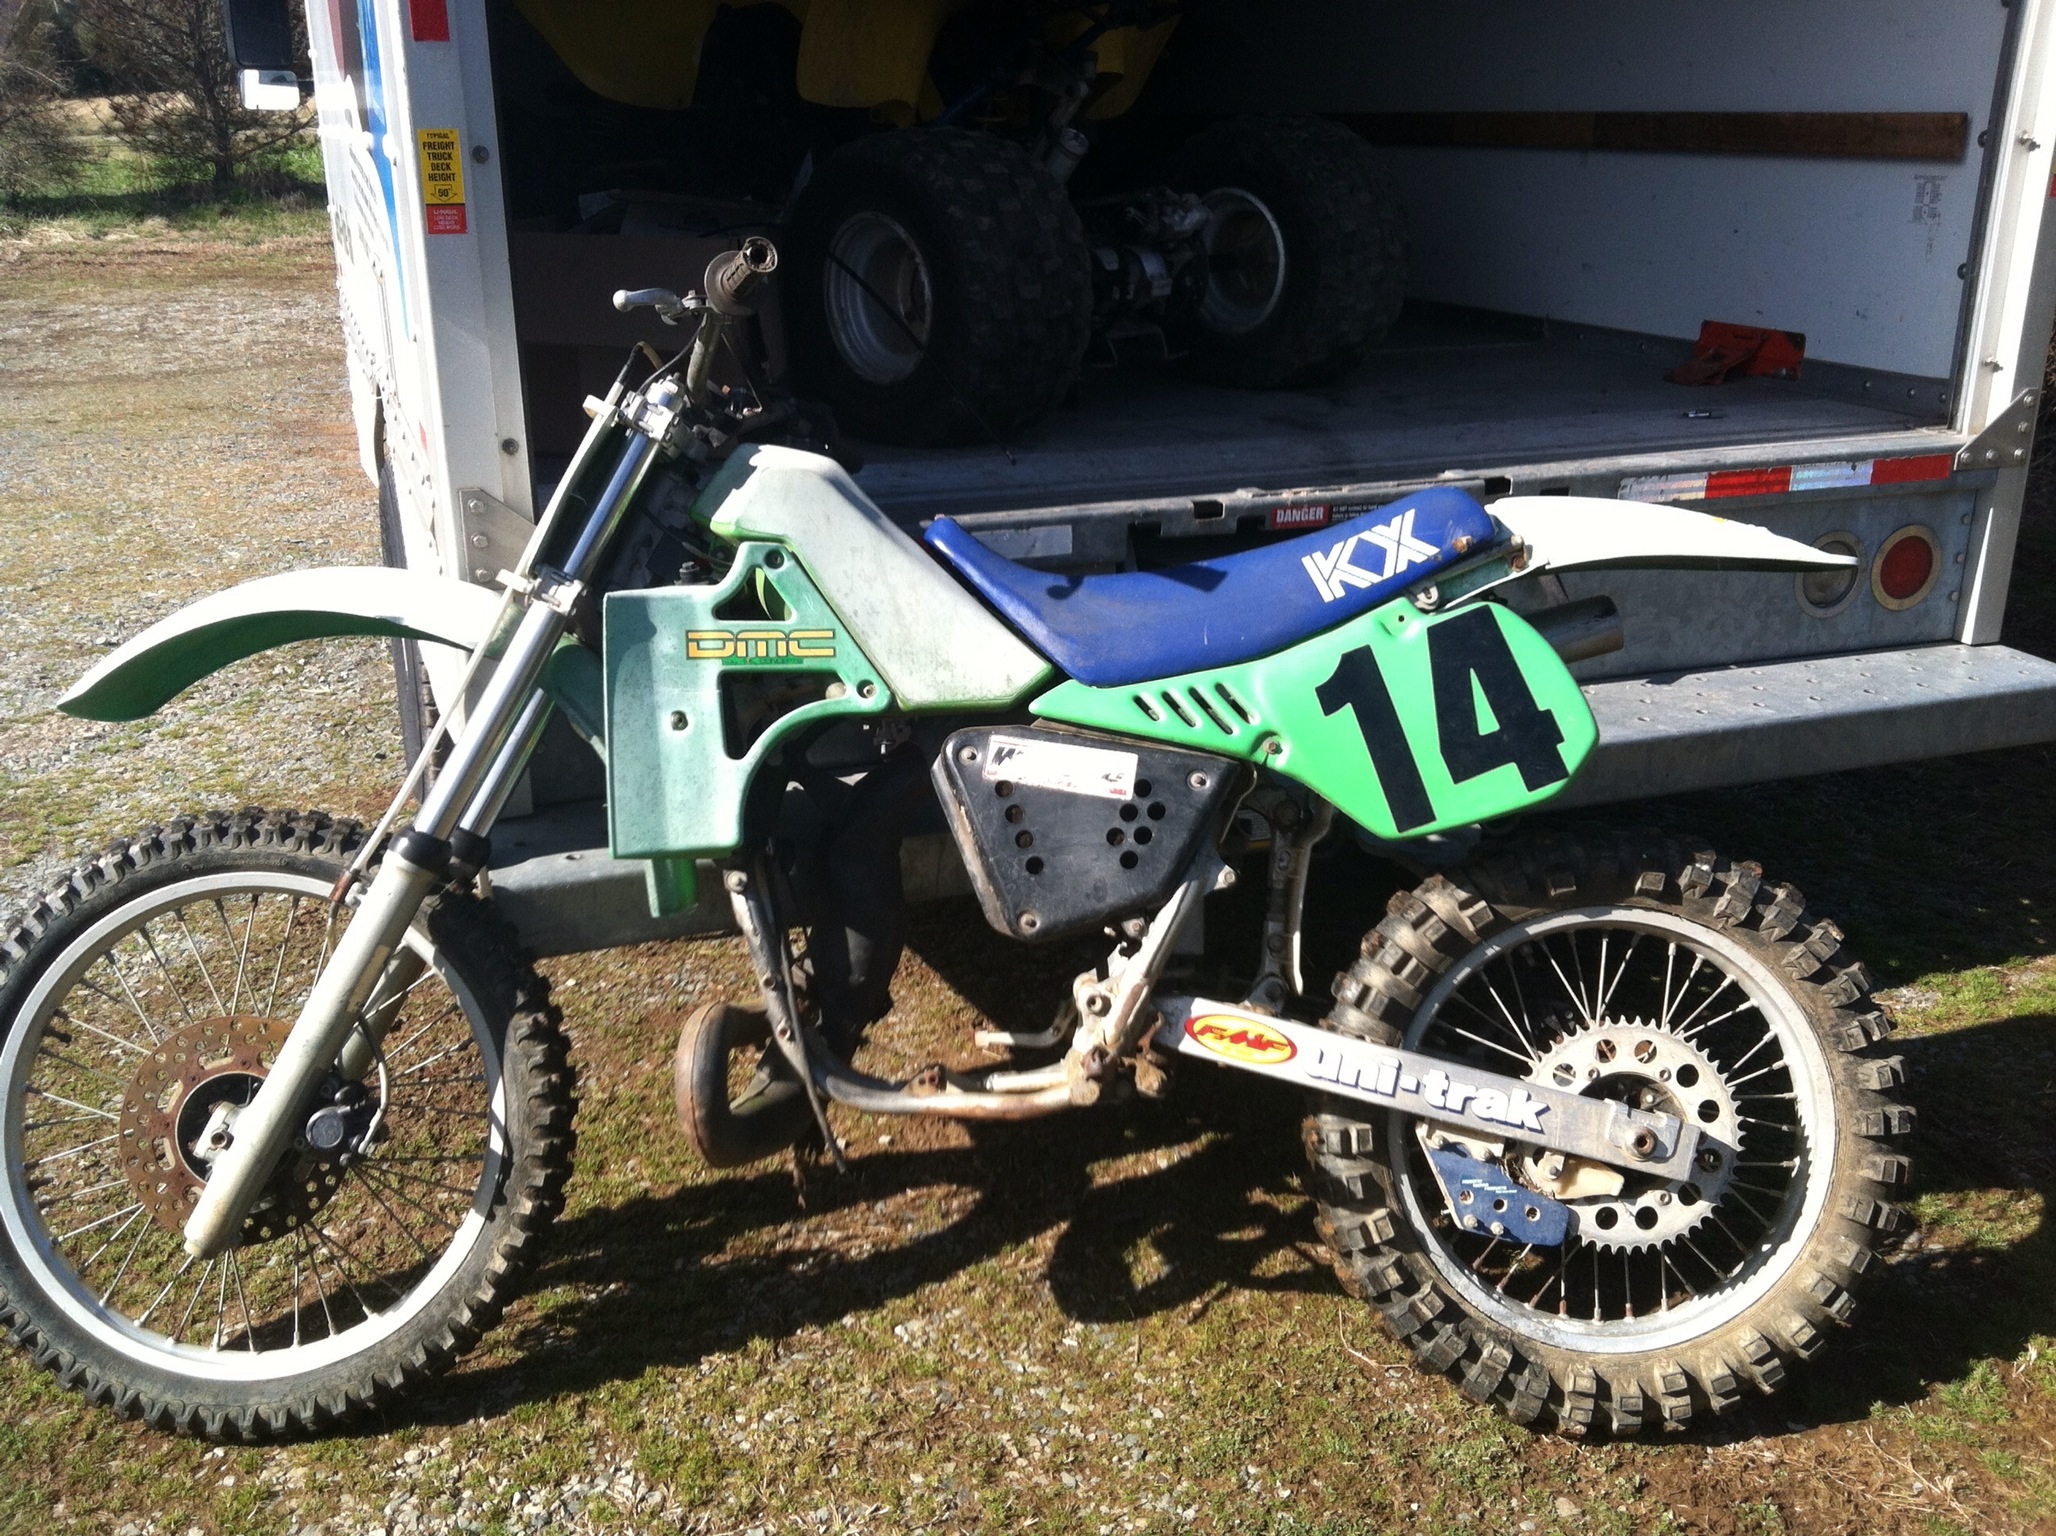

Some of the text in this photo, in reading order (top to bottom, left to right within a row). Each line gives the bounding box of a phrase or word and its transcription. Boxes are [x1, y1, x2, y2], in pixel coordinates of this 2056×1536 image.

[422, 141, 455, 151] FREIGHT
[426, 151, 453, 161] TRUCK
[430, 162, 452, 172] DECK
[428, 173, 456, 182] HEIGHT
[1276, 507, 1324, 523] DANGER
[1301, 508, 1440, 604] KX
[1315, 604, 1570, 834] 14
[1196, 1024, 1289, 1052] FMF
[1304, 1046, 1552, 1135] uni-trak
